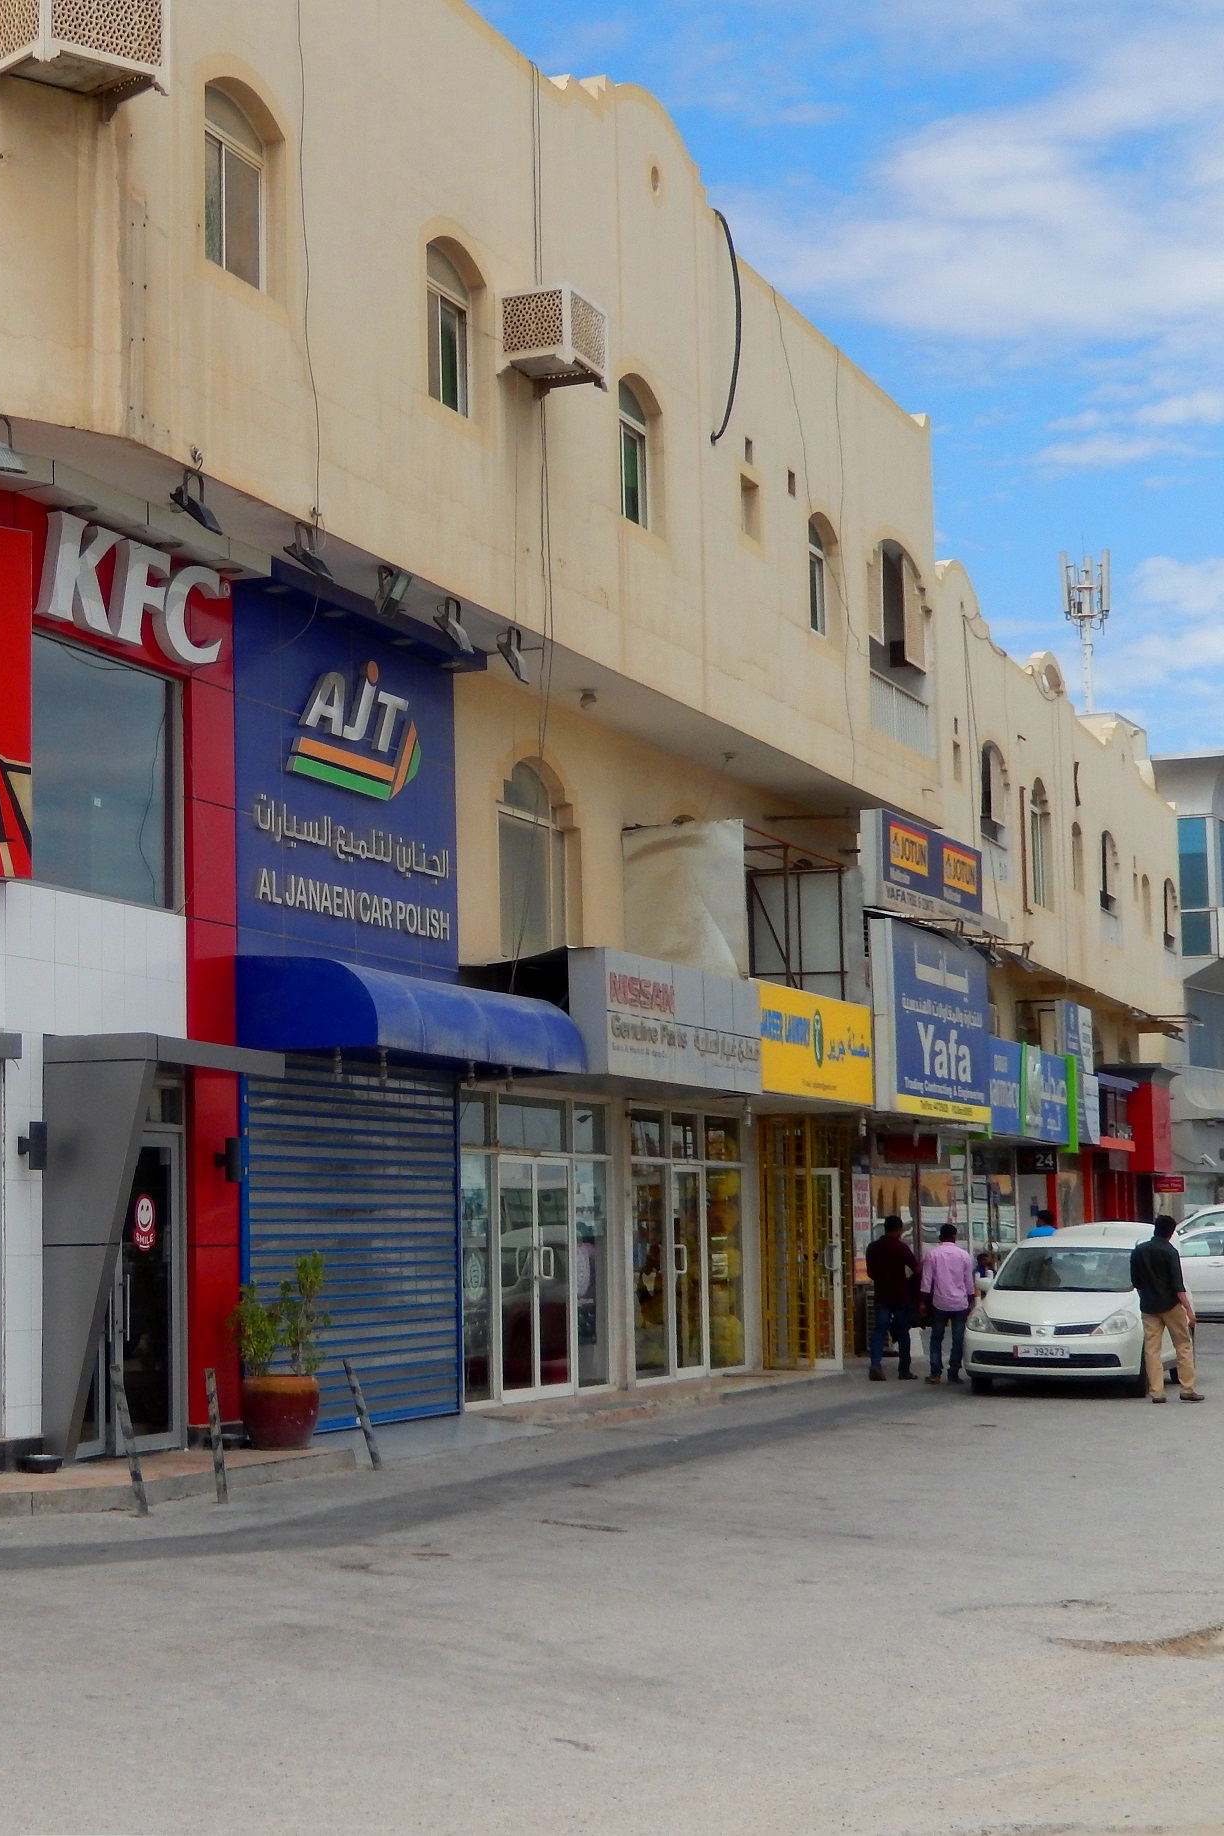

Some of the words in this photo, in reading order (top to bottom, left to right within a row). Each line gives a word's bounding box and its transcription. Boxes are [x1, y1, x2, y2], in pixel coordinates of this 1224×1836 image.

[38, 511, 223, 665] KFC
[255, 793, 333, 849] السيارات
[900, 836, 927, 868] JOTUN
[952, 857, 976, 886] JOTUN
[258, 867, 283, 905] AL
[285, 874, 356, 920] JANAEN
[359, 891, 394, 929] CAR
[396, 900, 451, 942] POLISH
[609, 971, 674, 1015] NISSAN
[610, 1014, 659, 1045] Genuine
[660, 1022, 688, 1050] Parts
[917, 1021, 971, 1084] Yafa
[1035, 1153, 1054, 1167] 24
[136, 1232, 154, 1245] SMILE
